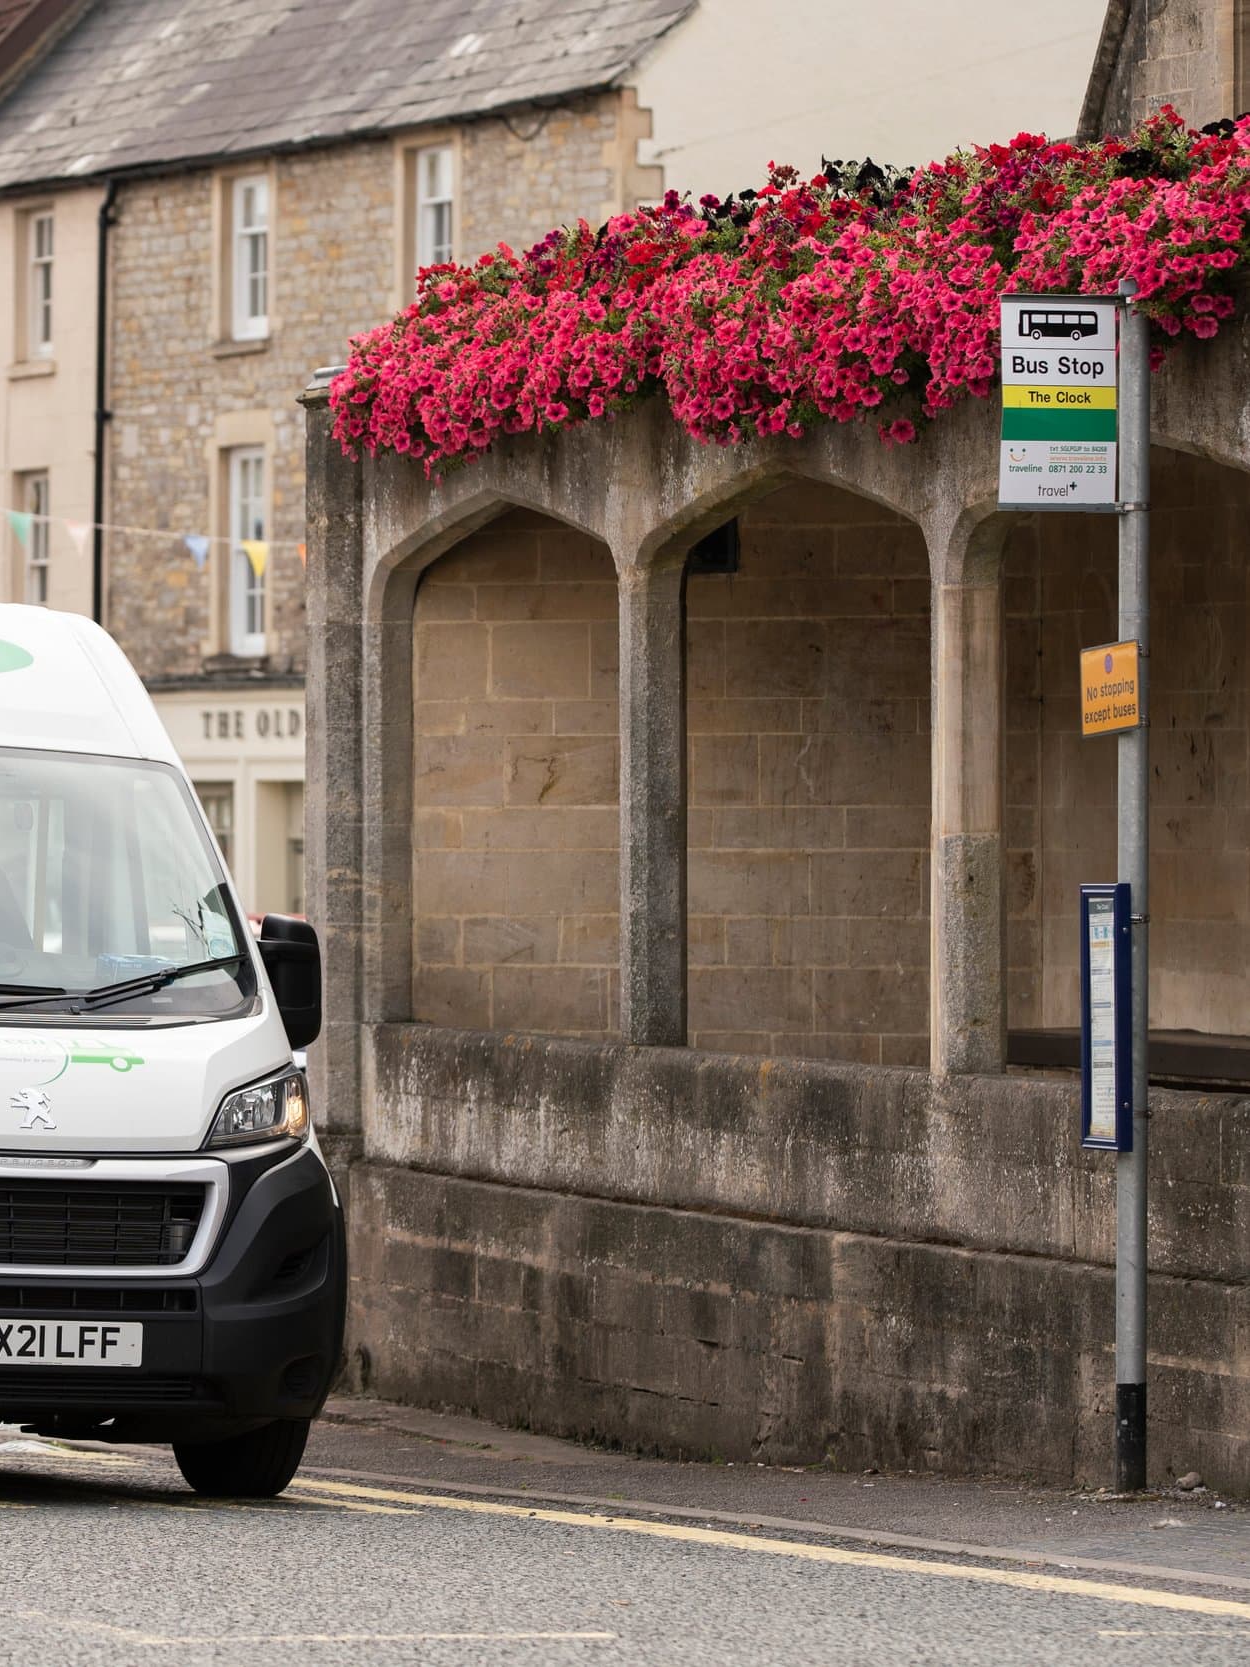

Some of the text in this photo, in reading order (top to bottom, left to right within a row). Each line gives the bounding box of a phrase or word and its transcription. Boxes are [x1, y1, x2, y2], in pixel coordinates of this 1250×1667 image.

[1012, 355, 1104, 379] Bus Stop
[1028, 391, 1091, 404] The Clock
[1009, 464, 1043, 473] traveline
[1049, 465, 1108, 474] 0871 200 22 33
[1086, 677, 1135, 702] No stopping
[1085, 703, 1136, 724] except buses
[201, 709, 301, 740] THE OLD
[0, 1158, 79, 1168] PEUGEOT
[56, 1325, 121, 1359] LFF
